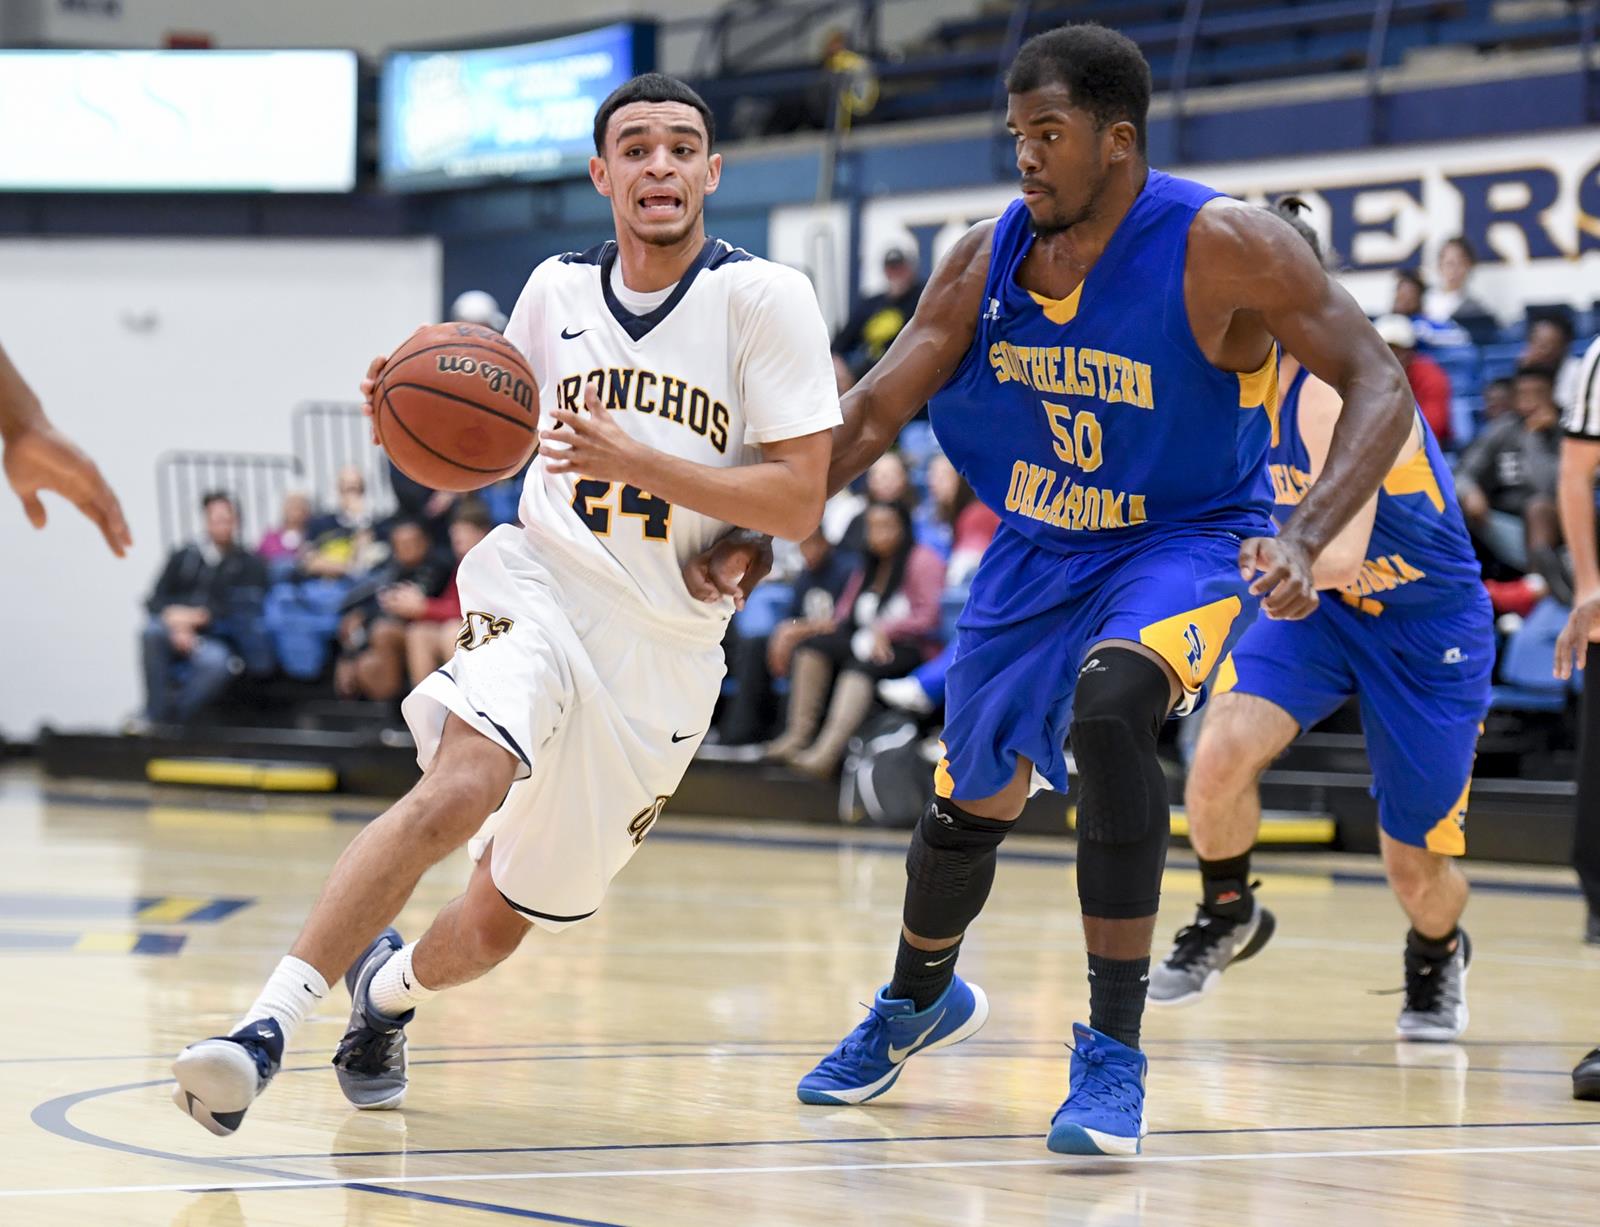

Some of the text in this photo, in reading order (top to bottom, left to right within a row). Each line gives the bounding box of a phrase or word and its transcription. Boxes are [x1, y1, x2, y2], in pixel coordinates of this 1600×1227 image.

[436, 354, 534, 413] Wilson
[989, 340, 1154, 410] SOUTHEASTERN
[553, 367, 729, 455] RONCHOS
[1041, 400, 1103, 472] 50
[570, 475, 673, 544] 24
[1005, 459, 1149, 531] OKLAHOMA
